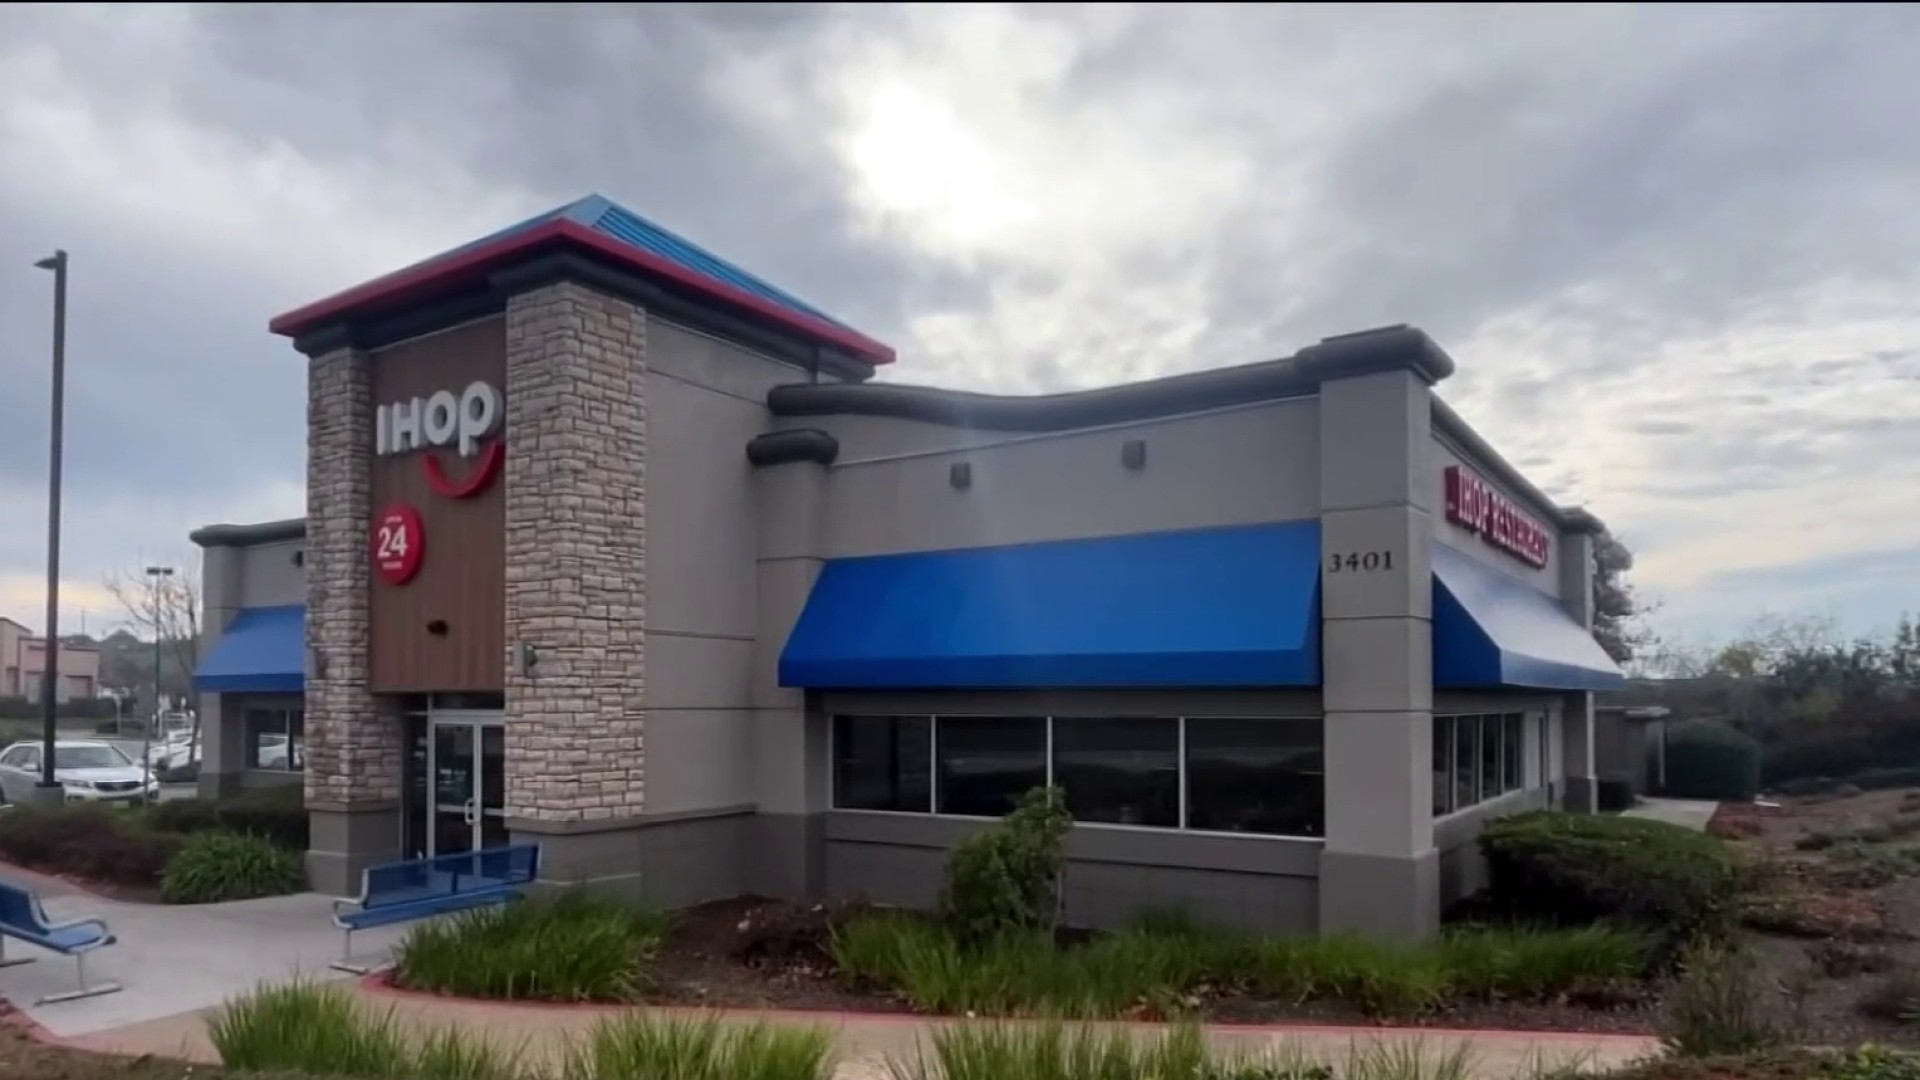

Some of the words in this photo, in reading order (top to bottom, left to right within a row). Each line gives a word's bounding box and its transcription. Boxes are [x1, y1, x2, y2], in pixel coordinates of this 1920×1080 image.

[376, 380, 498, 457] IHOP
[1457, 464, 1489, 533] IHOP
[377, 524, 408, 558] 24
[1327, 551, 1394, 573] 3401
